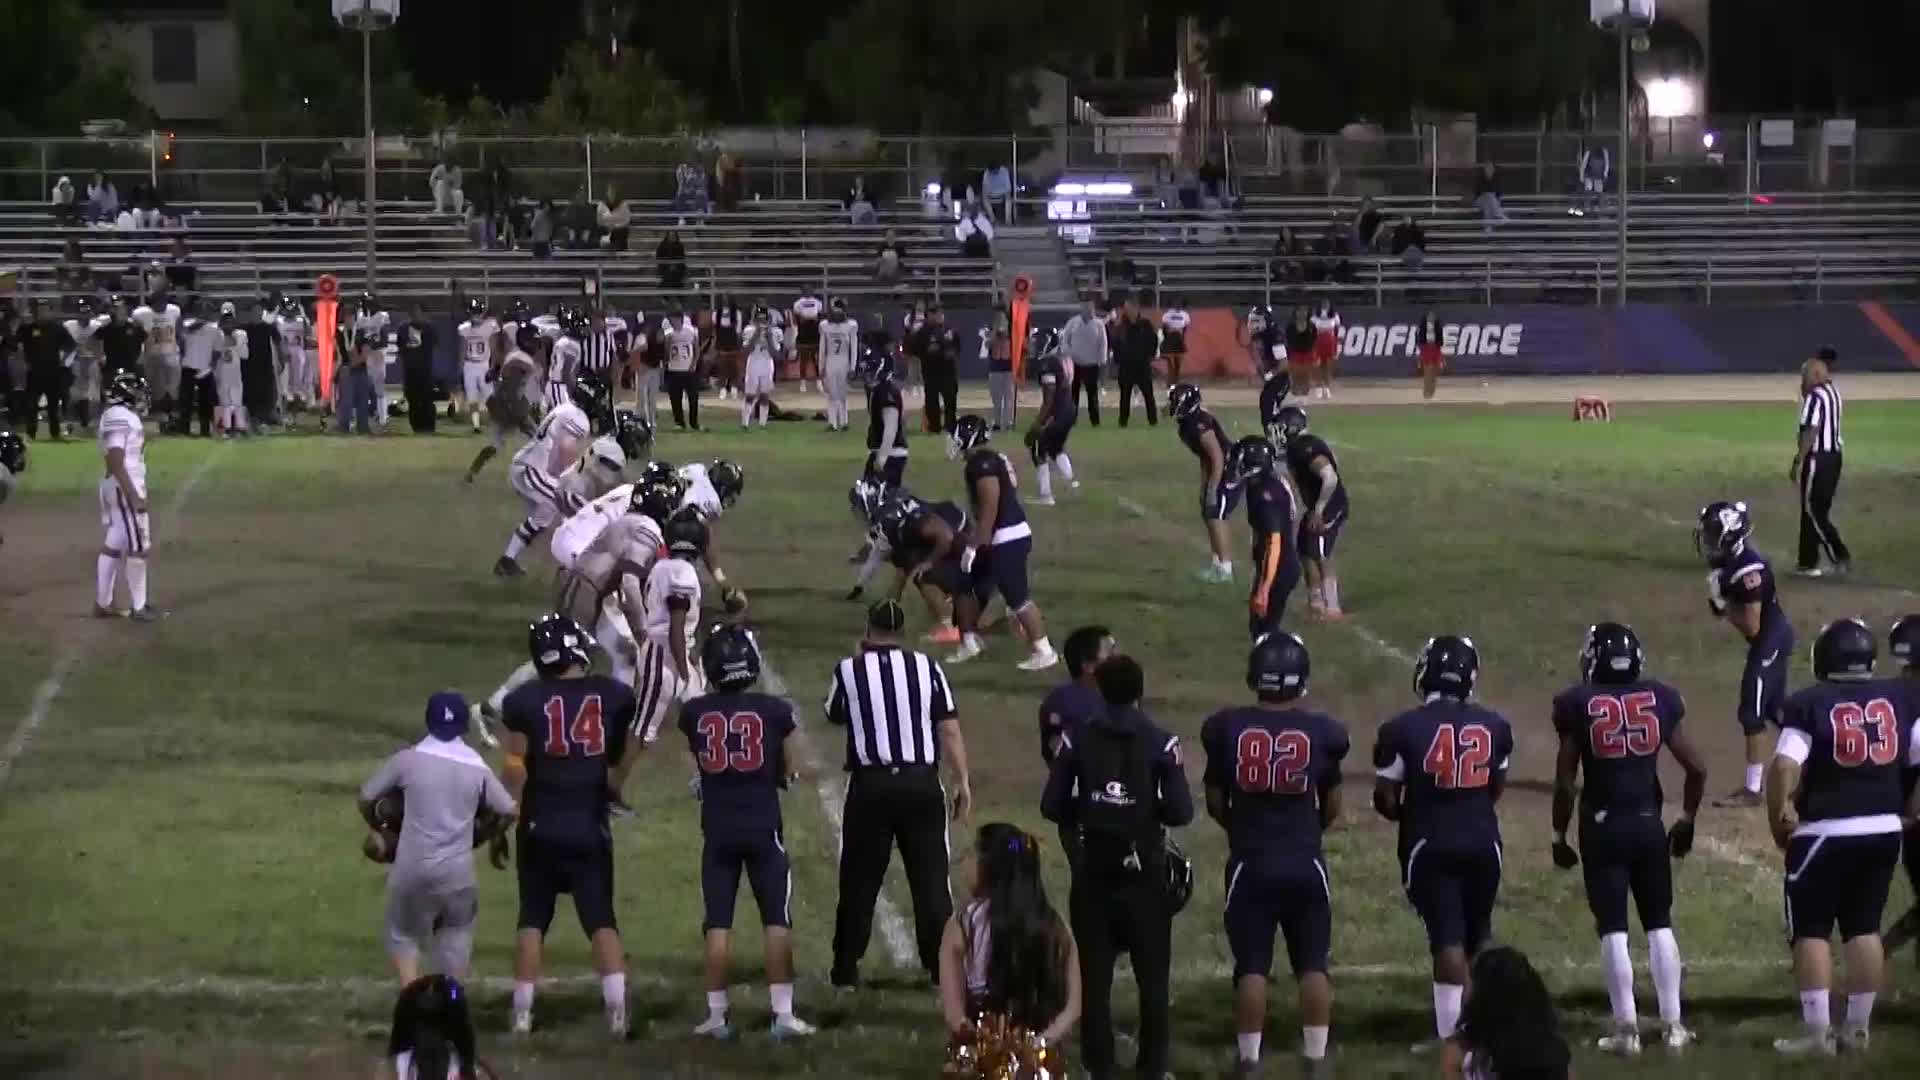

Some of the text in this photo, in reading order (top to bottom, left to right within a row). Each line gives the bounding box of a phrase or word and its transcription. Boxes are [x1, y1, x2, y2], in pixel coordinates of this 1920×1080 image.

[1337, 324, 1523, 356] ONFIENCE
[1579, 399, 1608, 420] 20
[544, 695, 605, 756] 14
[697, 711, 764, 772] 33
[1588, 690, 1660, 757] 25
[1830, 698, 1898, 767] 63
[1236, 728, 1311, 793] 82
[1423, 723, 1491, 789] 42
